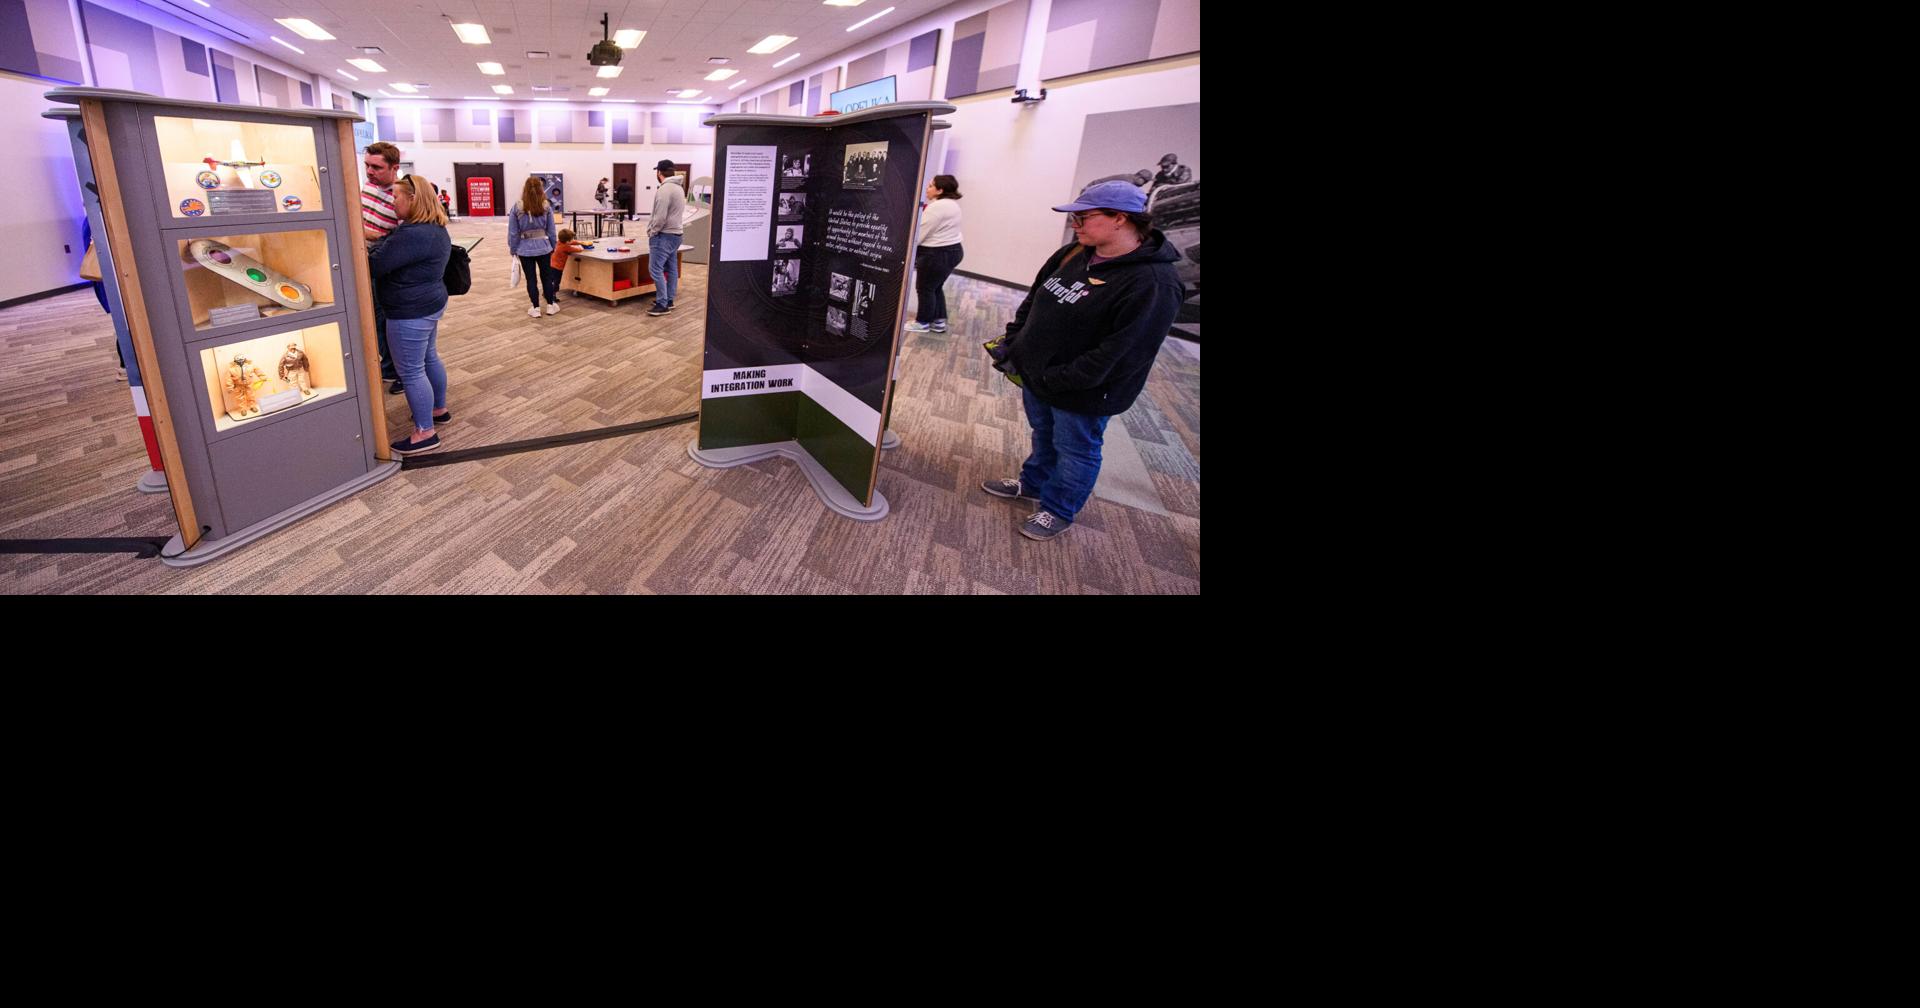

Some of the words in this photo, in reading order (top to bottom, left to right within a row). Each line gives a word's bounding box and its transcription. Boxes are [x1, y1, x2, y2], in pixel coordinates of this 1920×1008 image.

[733, 369, 766, 380] MAKING
[711, 380, 765, 393] INTEGRATION
[768, 378, 794, 388] WORK
